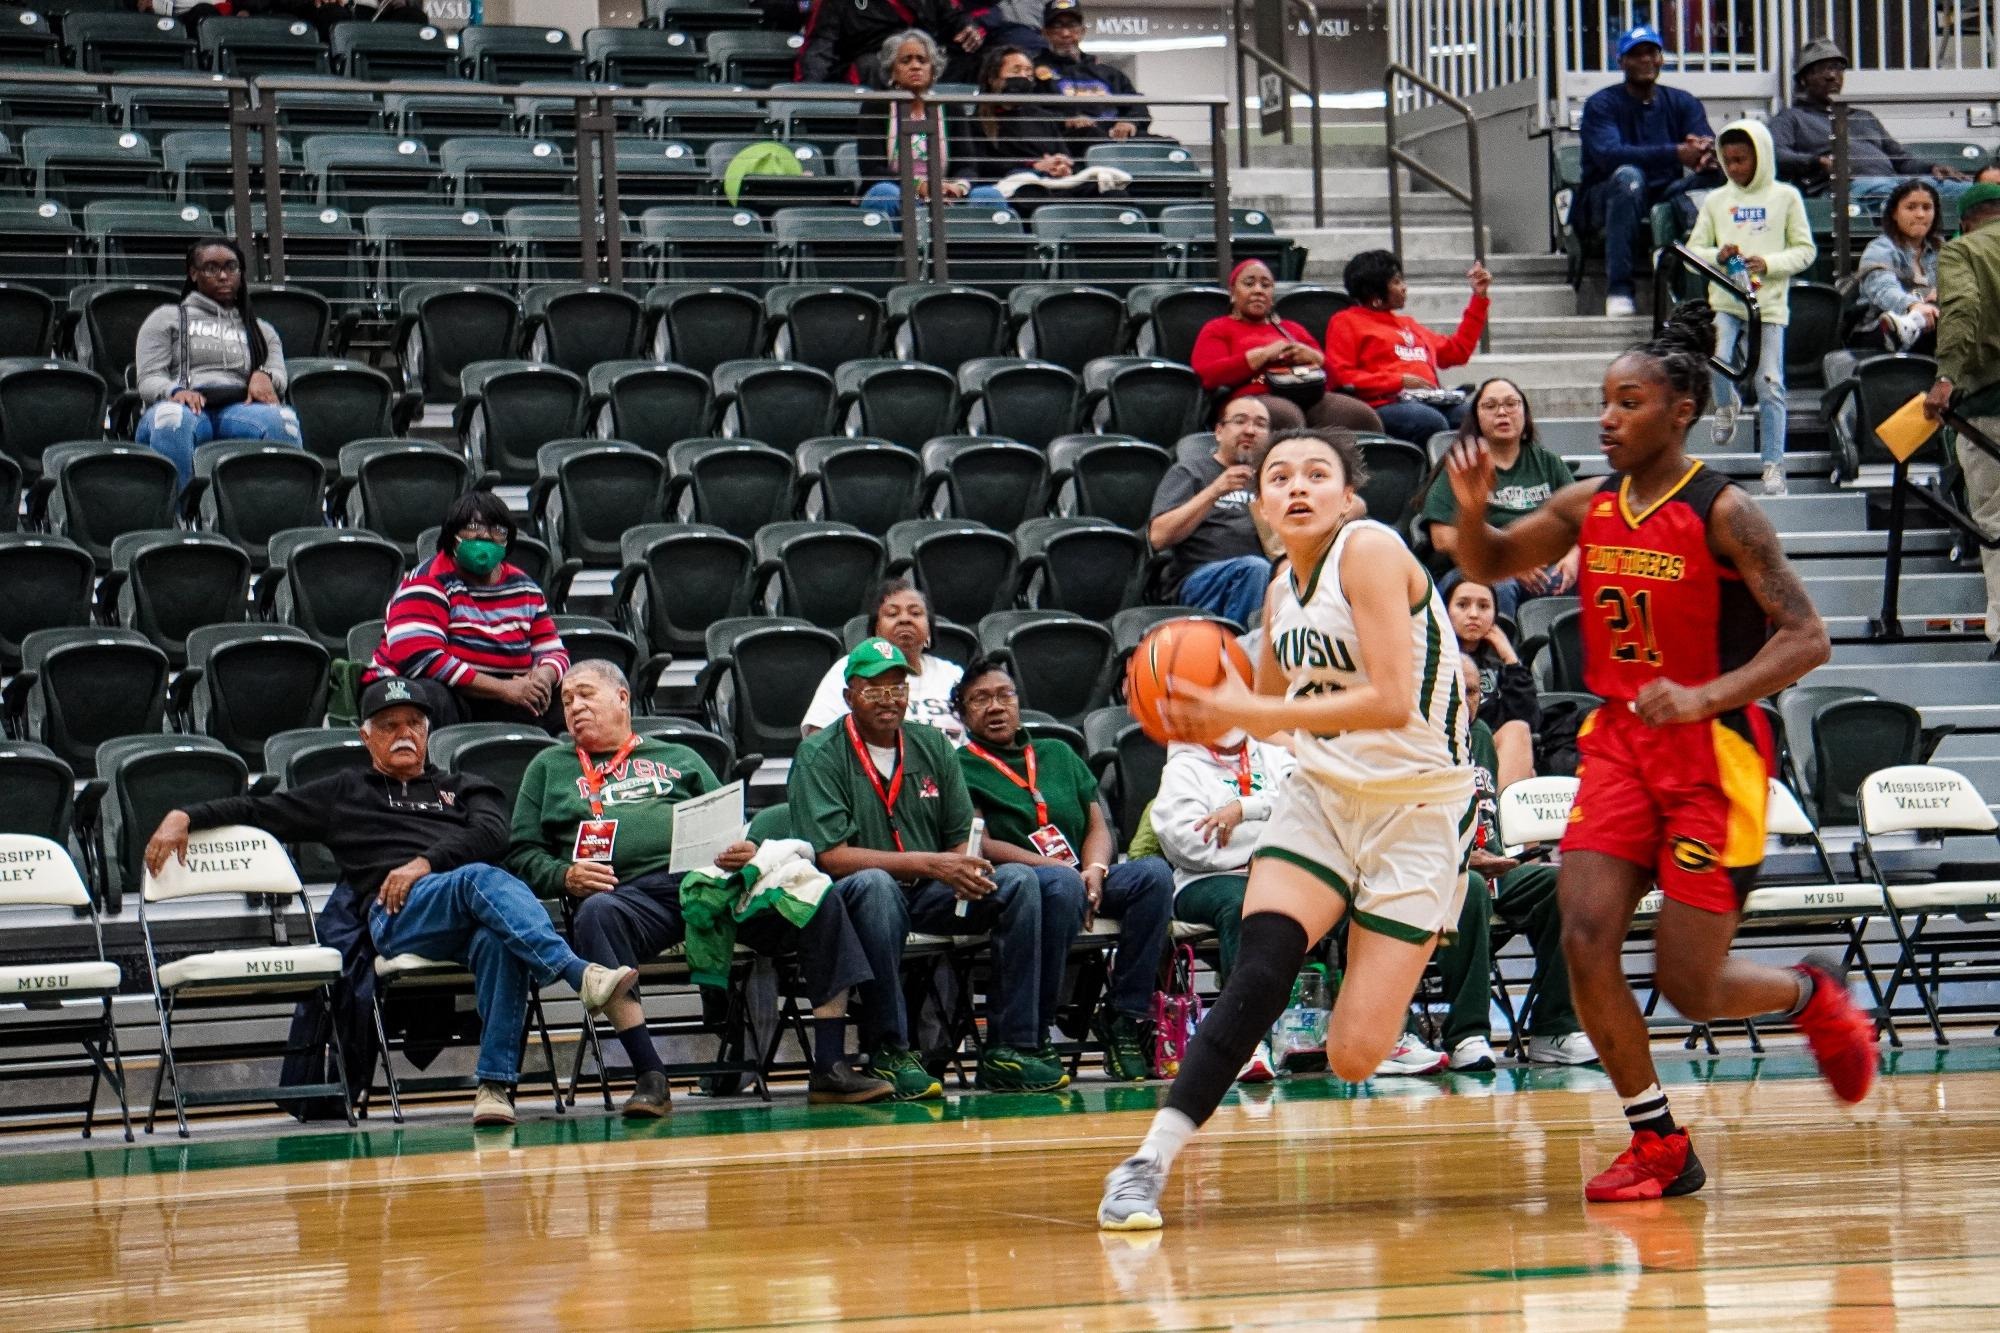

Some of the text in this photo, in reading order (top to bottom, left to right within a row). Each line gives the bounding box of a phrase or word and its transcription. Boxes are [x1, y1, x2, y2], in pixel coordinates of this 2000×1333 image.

[1096, 17, 1148, 35] MVSU
[1737, 209, 1763, 219] NIKE
[1594, 585, 1664, 667] 21
[1272, 626, 1357, 672] MVSU
[1876, 780, 1963, 794] MISSISSIPPI
[1895, 796, 1951, 810] VALLEY
[1533, 807, 1568, 821] VALL
[187, 839, 268, 855] SSISSIPPI
[186, 857, 252, 873] VALLEY
[1803, 892, 1845, 905] MVSU
[246, 960, 295, 974] MVSU
[17, 975, 70, 991] MVSU
